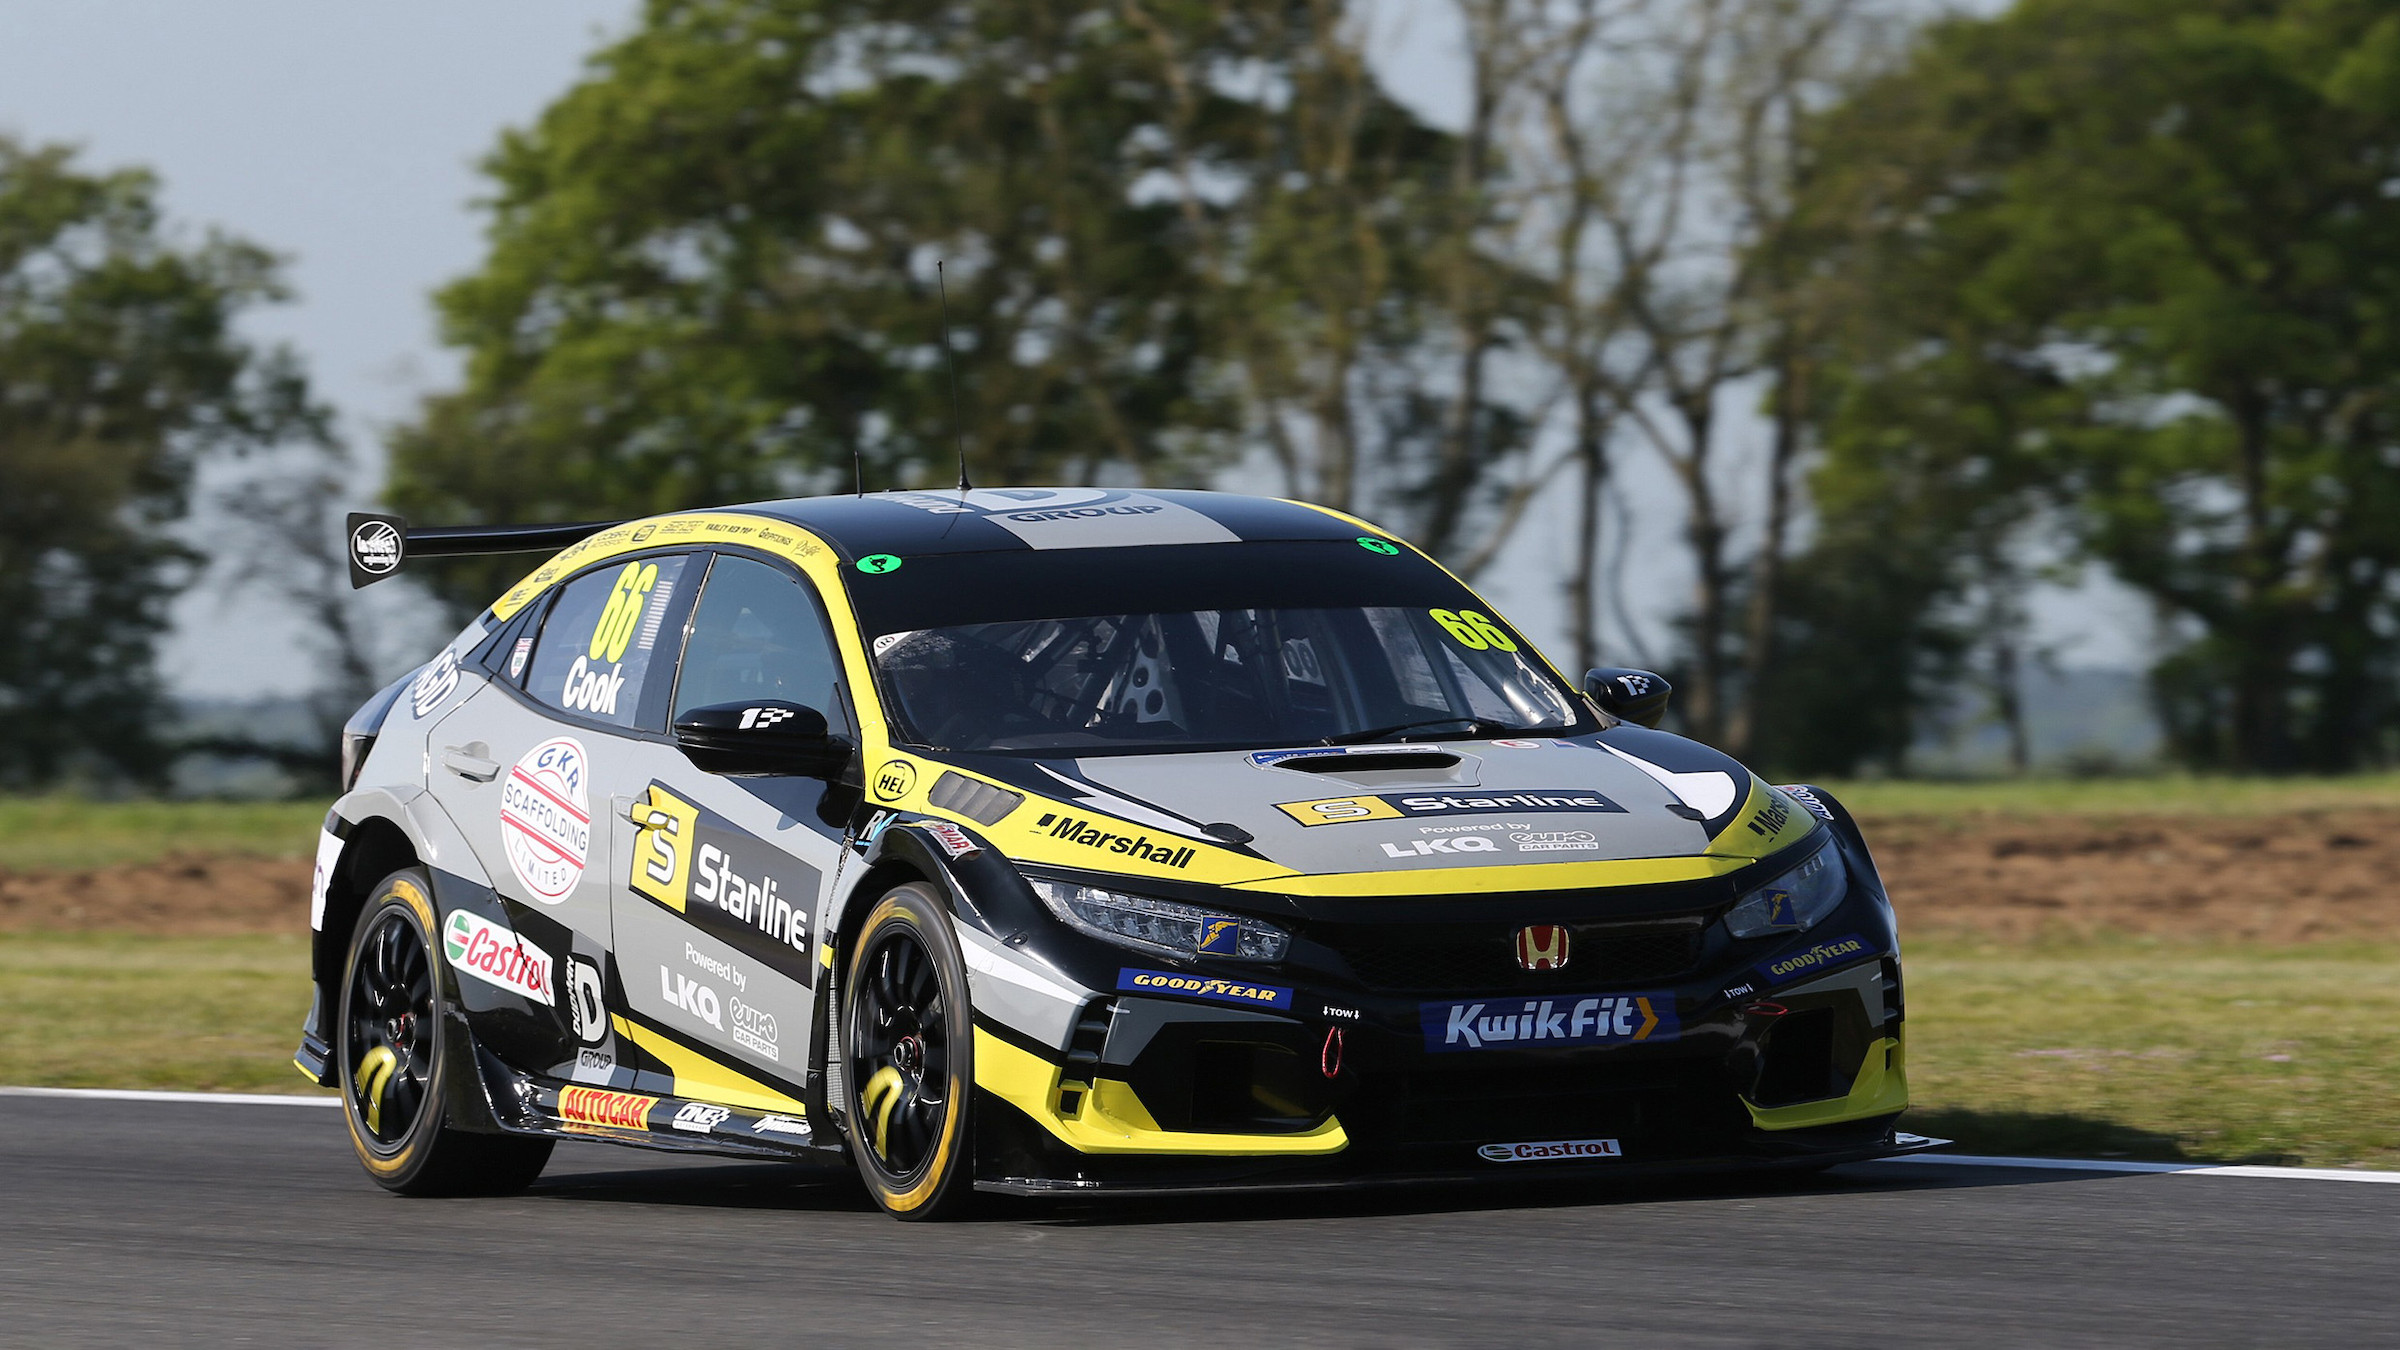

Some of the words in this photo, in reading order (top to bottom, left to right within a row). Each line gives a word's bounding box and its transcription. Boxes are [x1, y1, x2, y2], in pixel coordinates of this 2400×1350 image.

[1008, 505, 1163, 522] GROUP
[589, 561, 658, 663] 66
[1428, 608, 1518, 652] 66
[562, 655, 625, 715] Cook
[537, 748, 579, 796] GKR
[878, 774, 906, 794] HEL
[505, 784, 587, 851] SCAFFOLDING
[1401, 792, 1604, 812] Starline
[1050, 817, 1196, 869] Marshall
[1380, 836, 1501, 858] LKQ
[1419, 823, 1503, 834] Powered
[1506, 822, 1531, 831] by
[1509, 831, 1596, 844] euro
[515, 839, 567, 886] LIMITED
[694, 843, 808, 953] Starline
[467, 928, 550, 995] Castrol
[685, 942, 730, 981] Powered
[733, 966, 747, 992] by
[566, 955, 582, 1036] DUDMAN
[660, 965, 725, 1032] LKQ
[1330, 1008, 1354, 1018] TOW
[1730, 986, 1750, 997] TOW
[729, 996, 778, 1042] euro
[581, 1050, 612, 1070] GROUP
[735, 1030, 751, 1046] CAR
[752, 1037, 777, 1058] PARTS
[565, 1088, 650, 1128] AUTOCAR
[1515, 1141, 1614, 1158] Castrol
